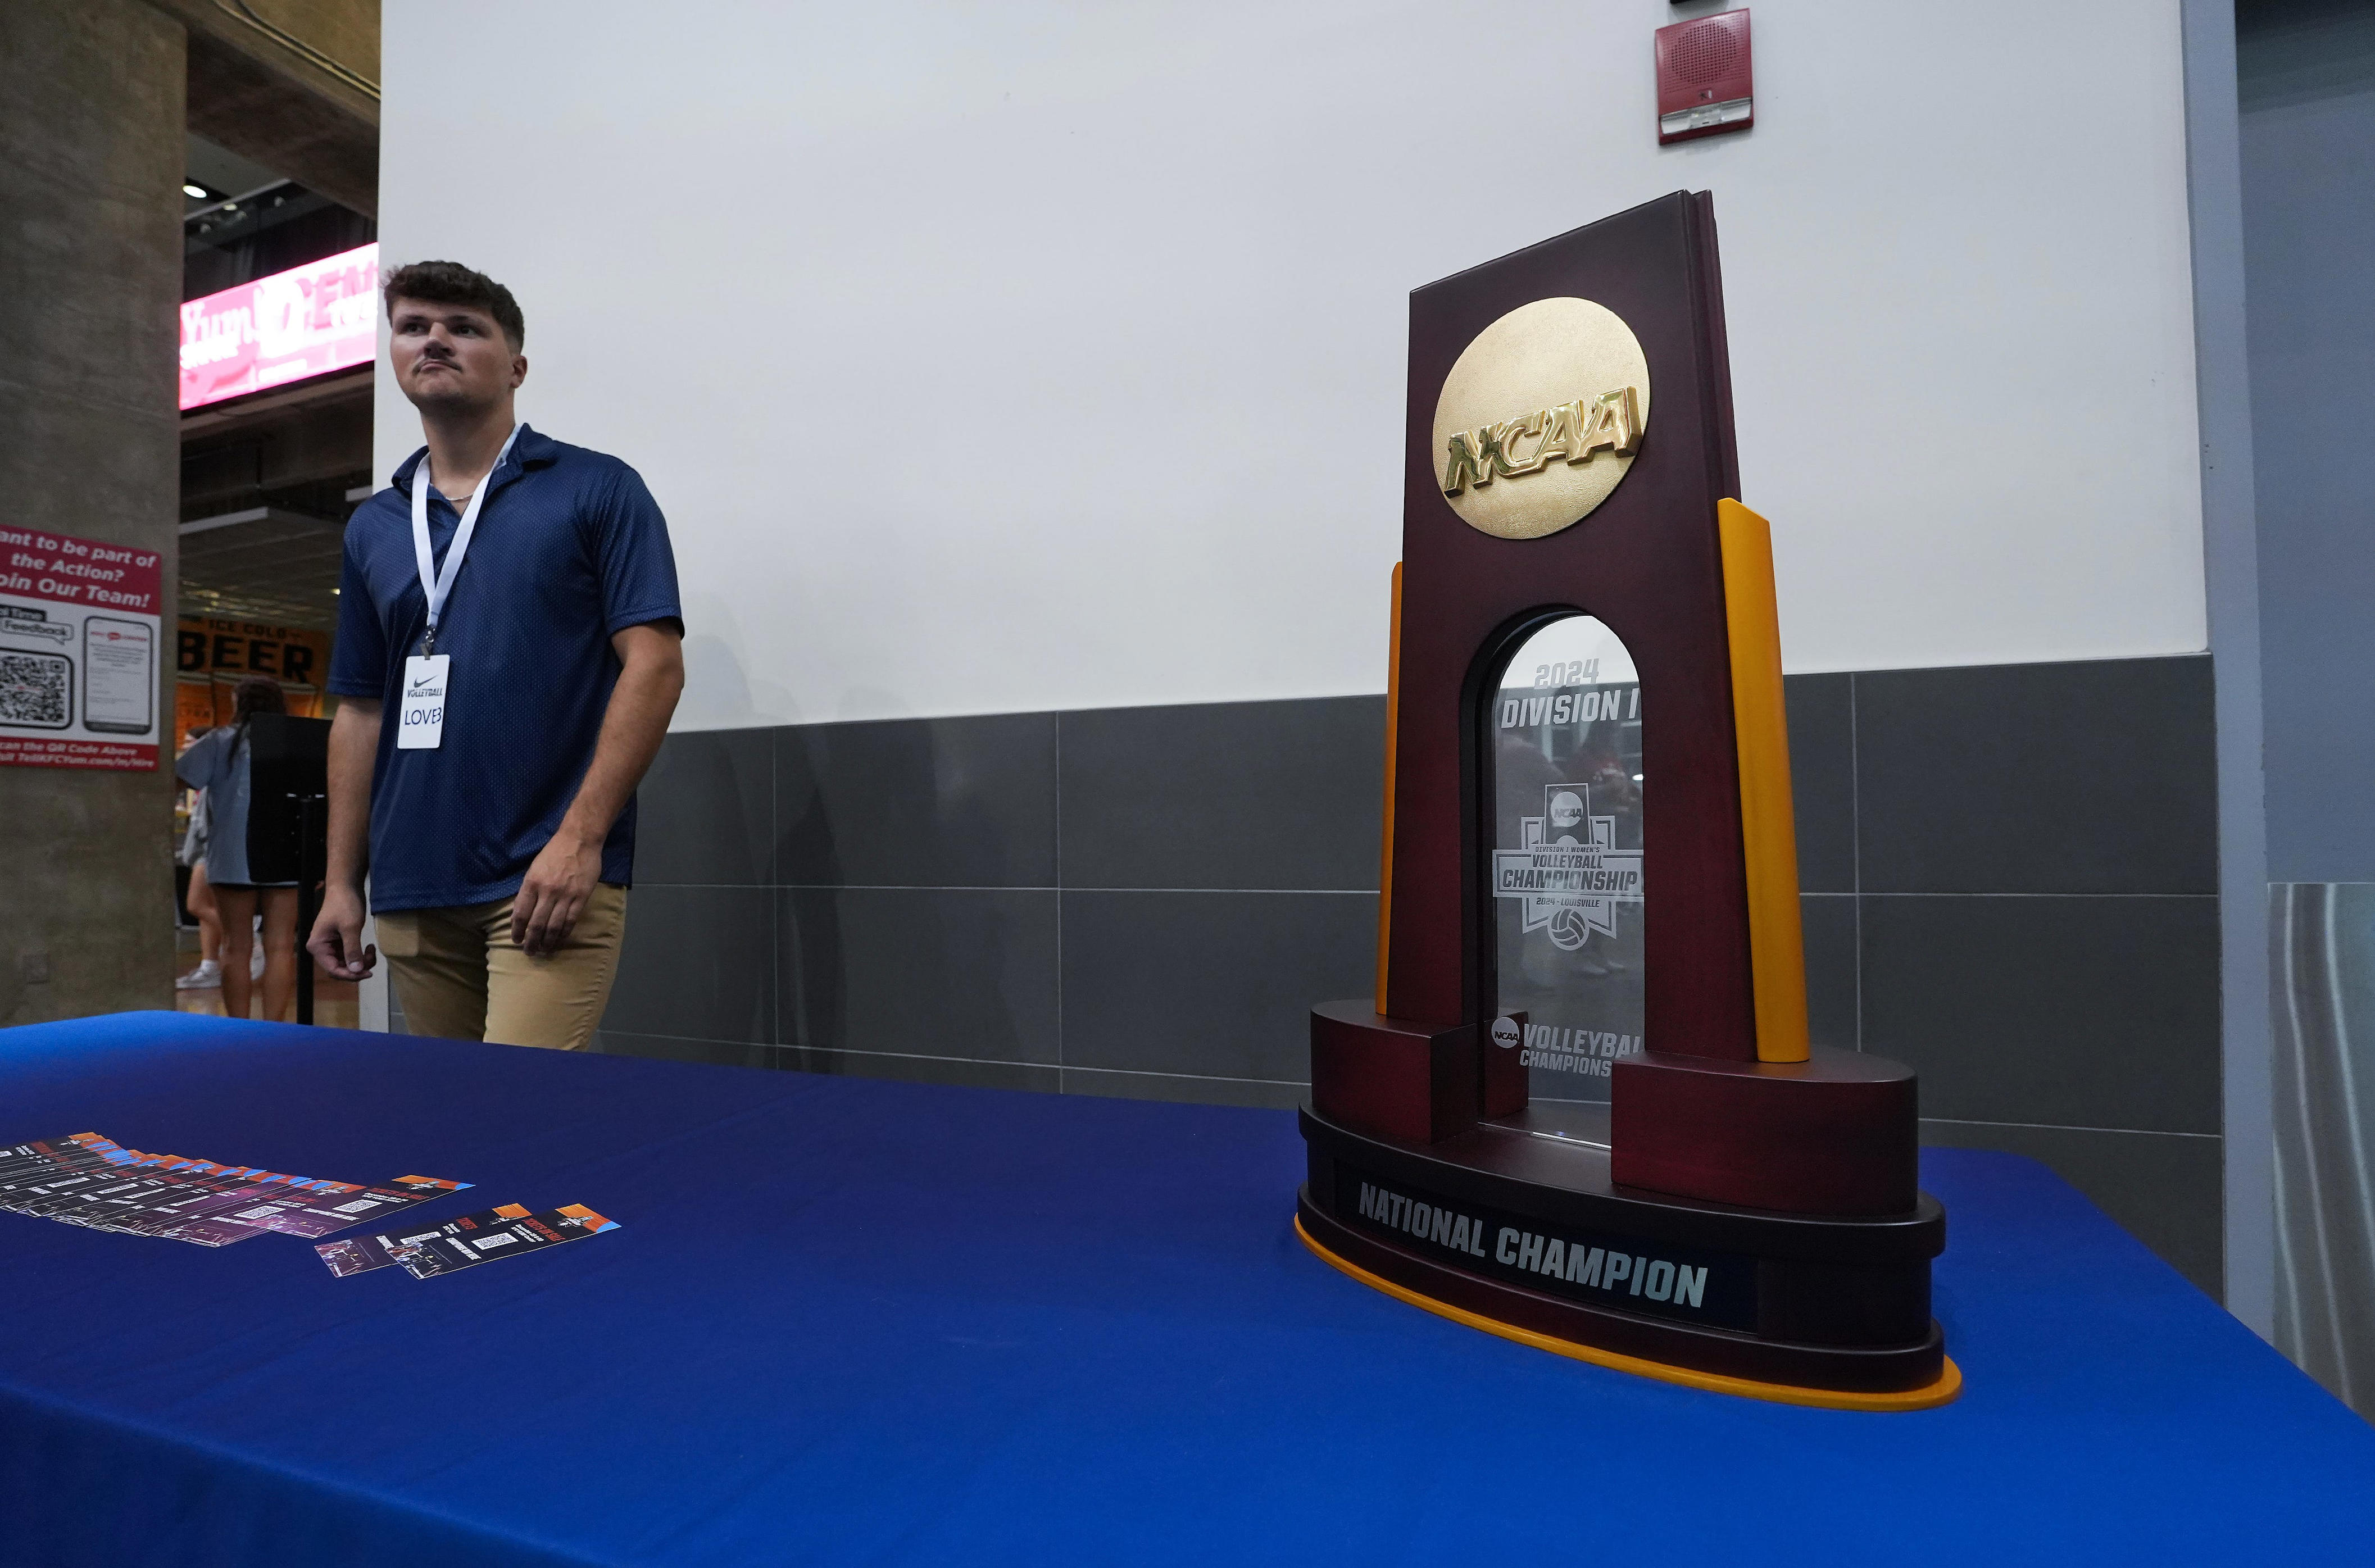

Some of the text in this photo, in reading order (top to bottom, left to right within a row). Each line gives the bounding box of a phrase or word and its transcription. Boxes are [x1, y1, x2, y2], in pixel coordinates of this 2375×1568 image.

[1444, 386, 1642, 498] NCAA
[37, 536, 58, 551] to
[62, 540, 88, 557] be
[92, 547, 132, 564] part
[135, 555, 157, 568] of
[11, 553, 125, 582] the Action?
[38, 578, 81, 597] Our
[86, 584, 151, 608] Team!
[208, 619, 286, 638] ICE COLD
[177, 630, 313, 683] BEER
[1534, 658, 1599, 689] 2024
[407, 688, 442, 697] VOLLEYBALL
[405, 707, 442, 725] LOVB
[1501, 689, 1621, 729] DIVISION
[47, 742, 66, 752] QR
[68, 744, 99, 754] Code
[1555, 808, 1582, 818] NCAA
[1532, 855, 1603, 869] VOLLEYBALL
[1502, 869, 1637, 891] CHAMPIONSHIP
[1537, 897, 1555, 906] 2024
[1560, 898, 1600, 908] LOUISVILLE
[1494, 1031, 1519, 1041] NCAA
[1359, 1182, 1708, 1308] NATIONAL CHAMPION
